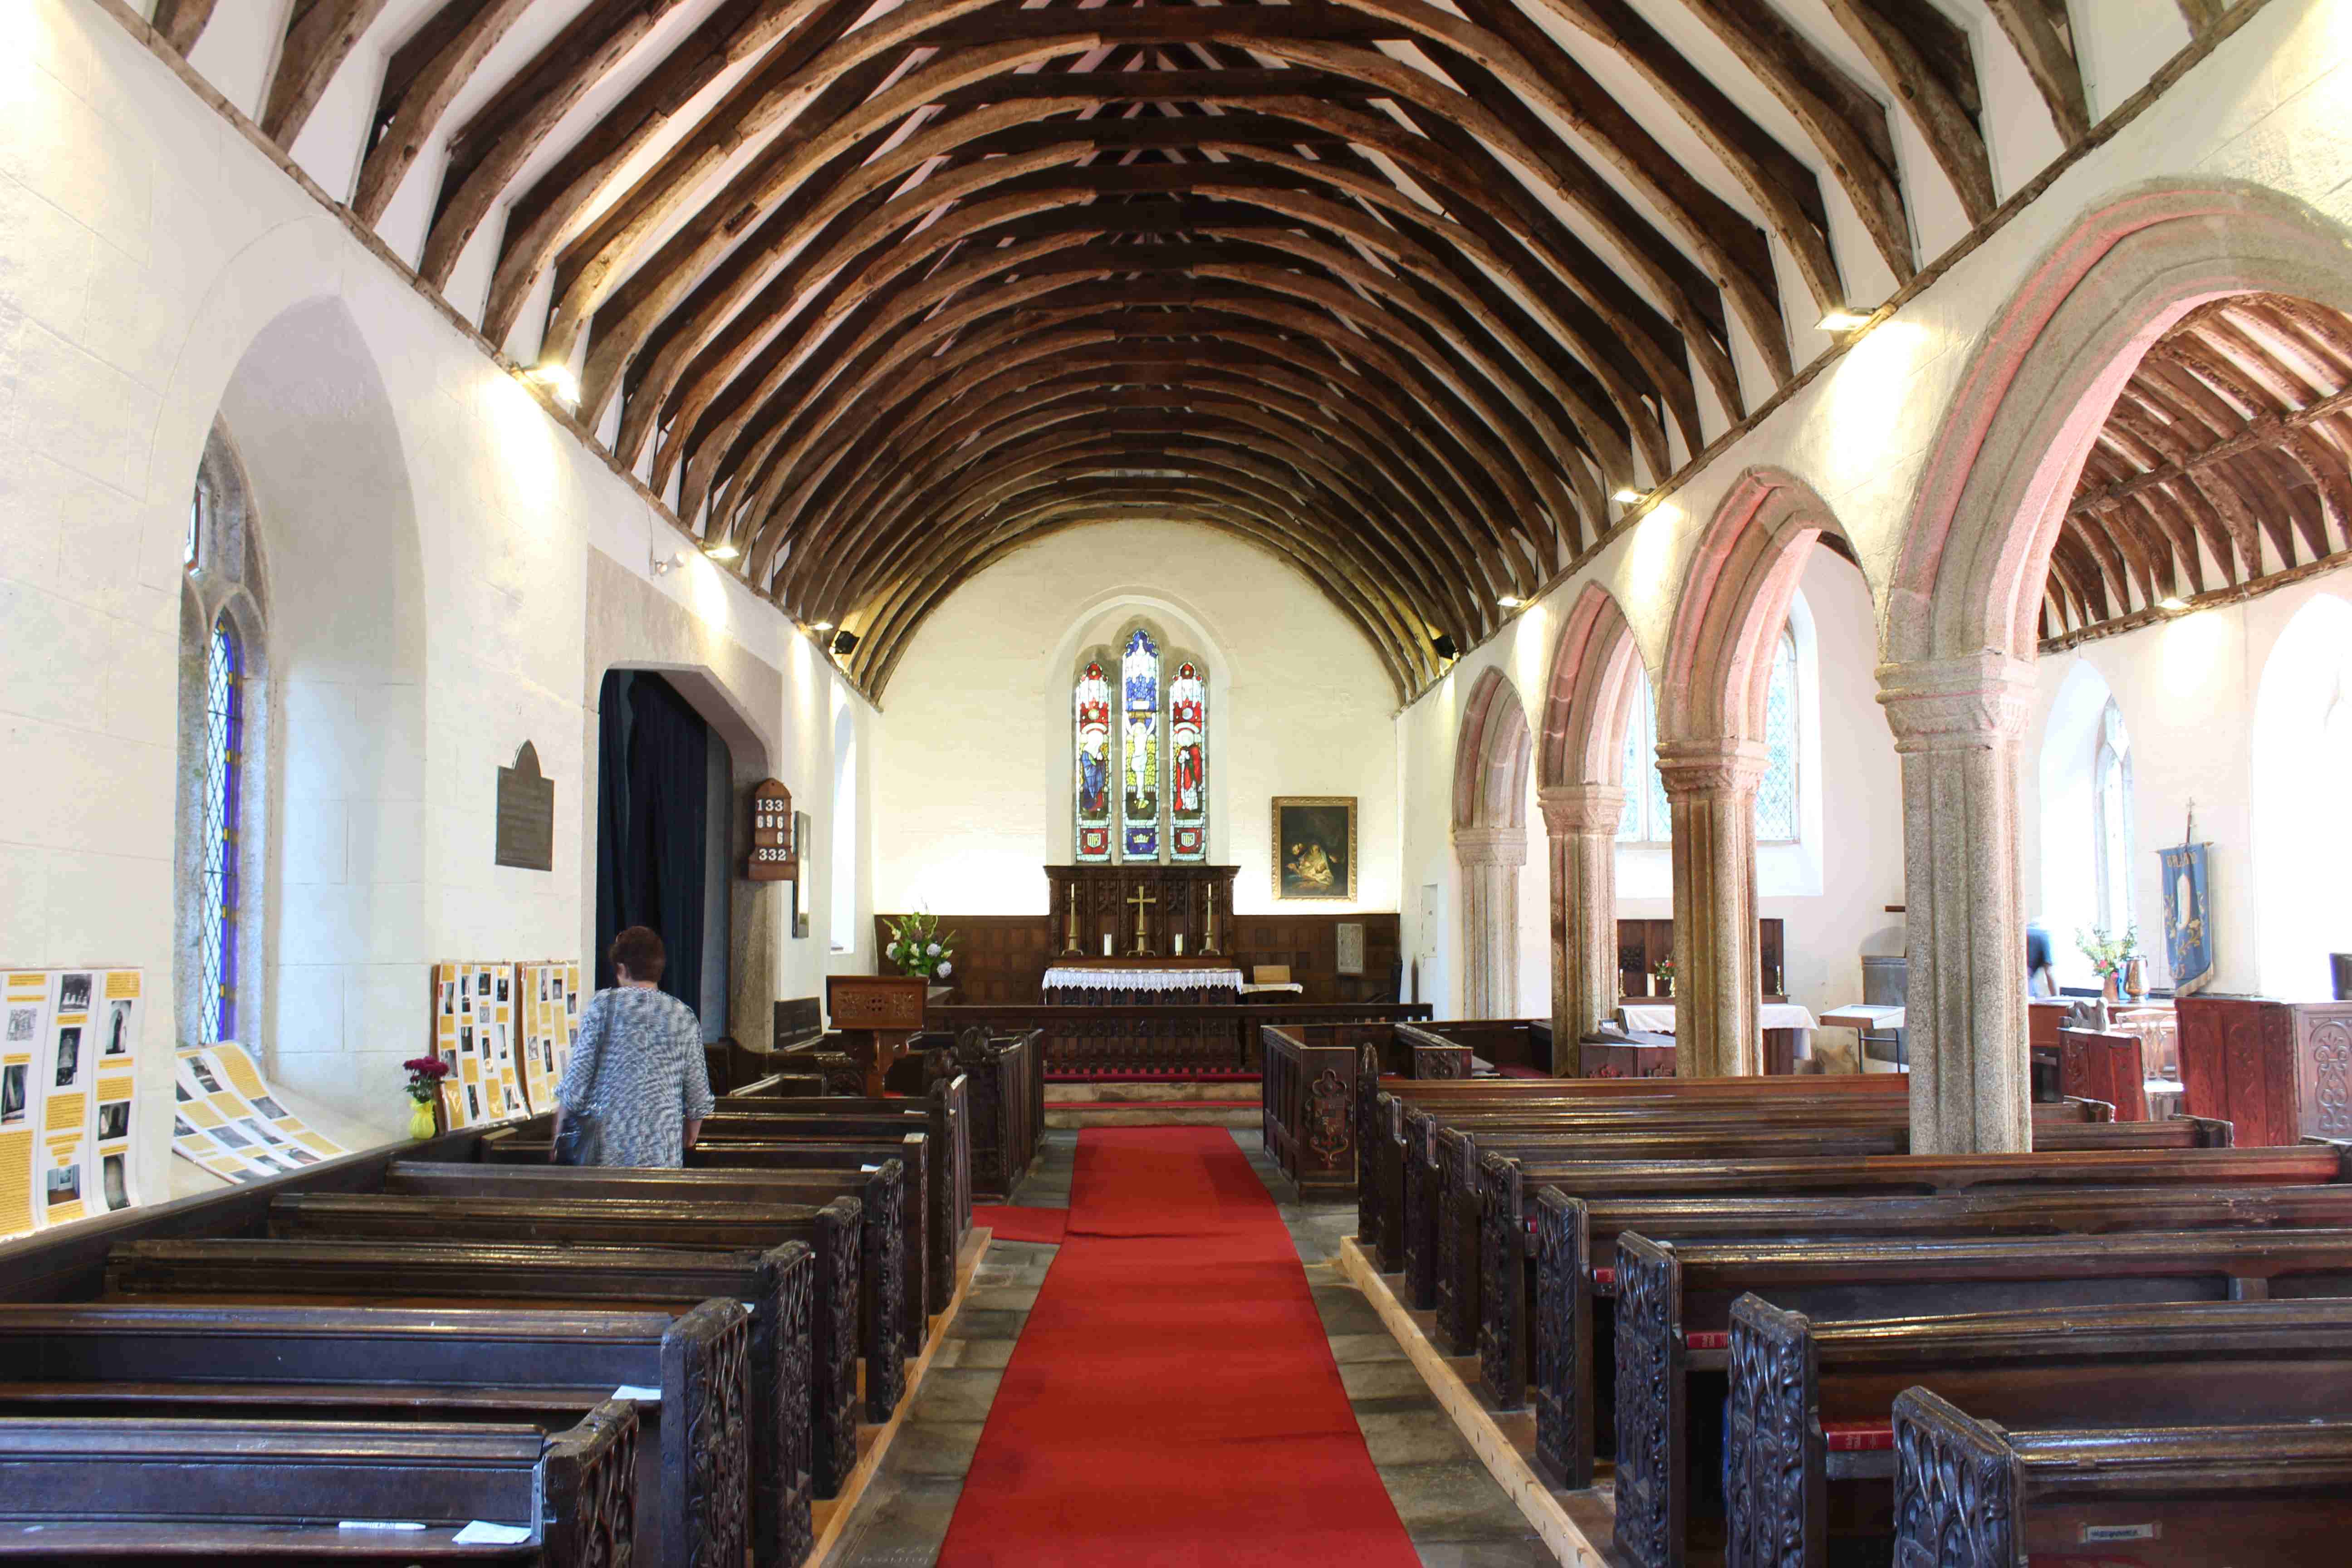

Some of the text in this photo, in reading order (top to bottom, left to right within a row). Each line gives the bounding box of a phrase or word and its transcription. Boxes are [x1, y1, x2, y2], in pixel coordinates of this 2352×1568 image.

[757, 799, 784, 811] 133
[757, 815, 784, 829] 696
[777, 831, 784, 844] 6
[759, 848, 787, 861] 332
